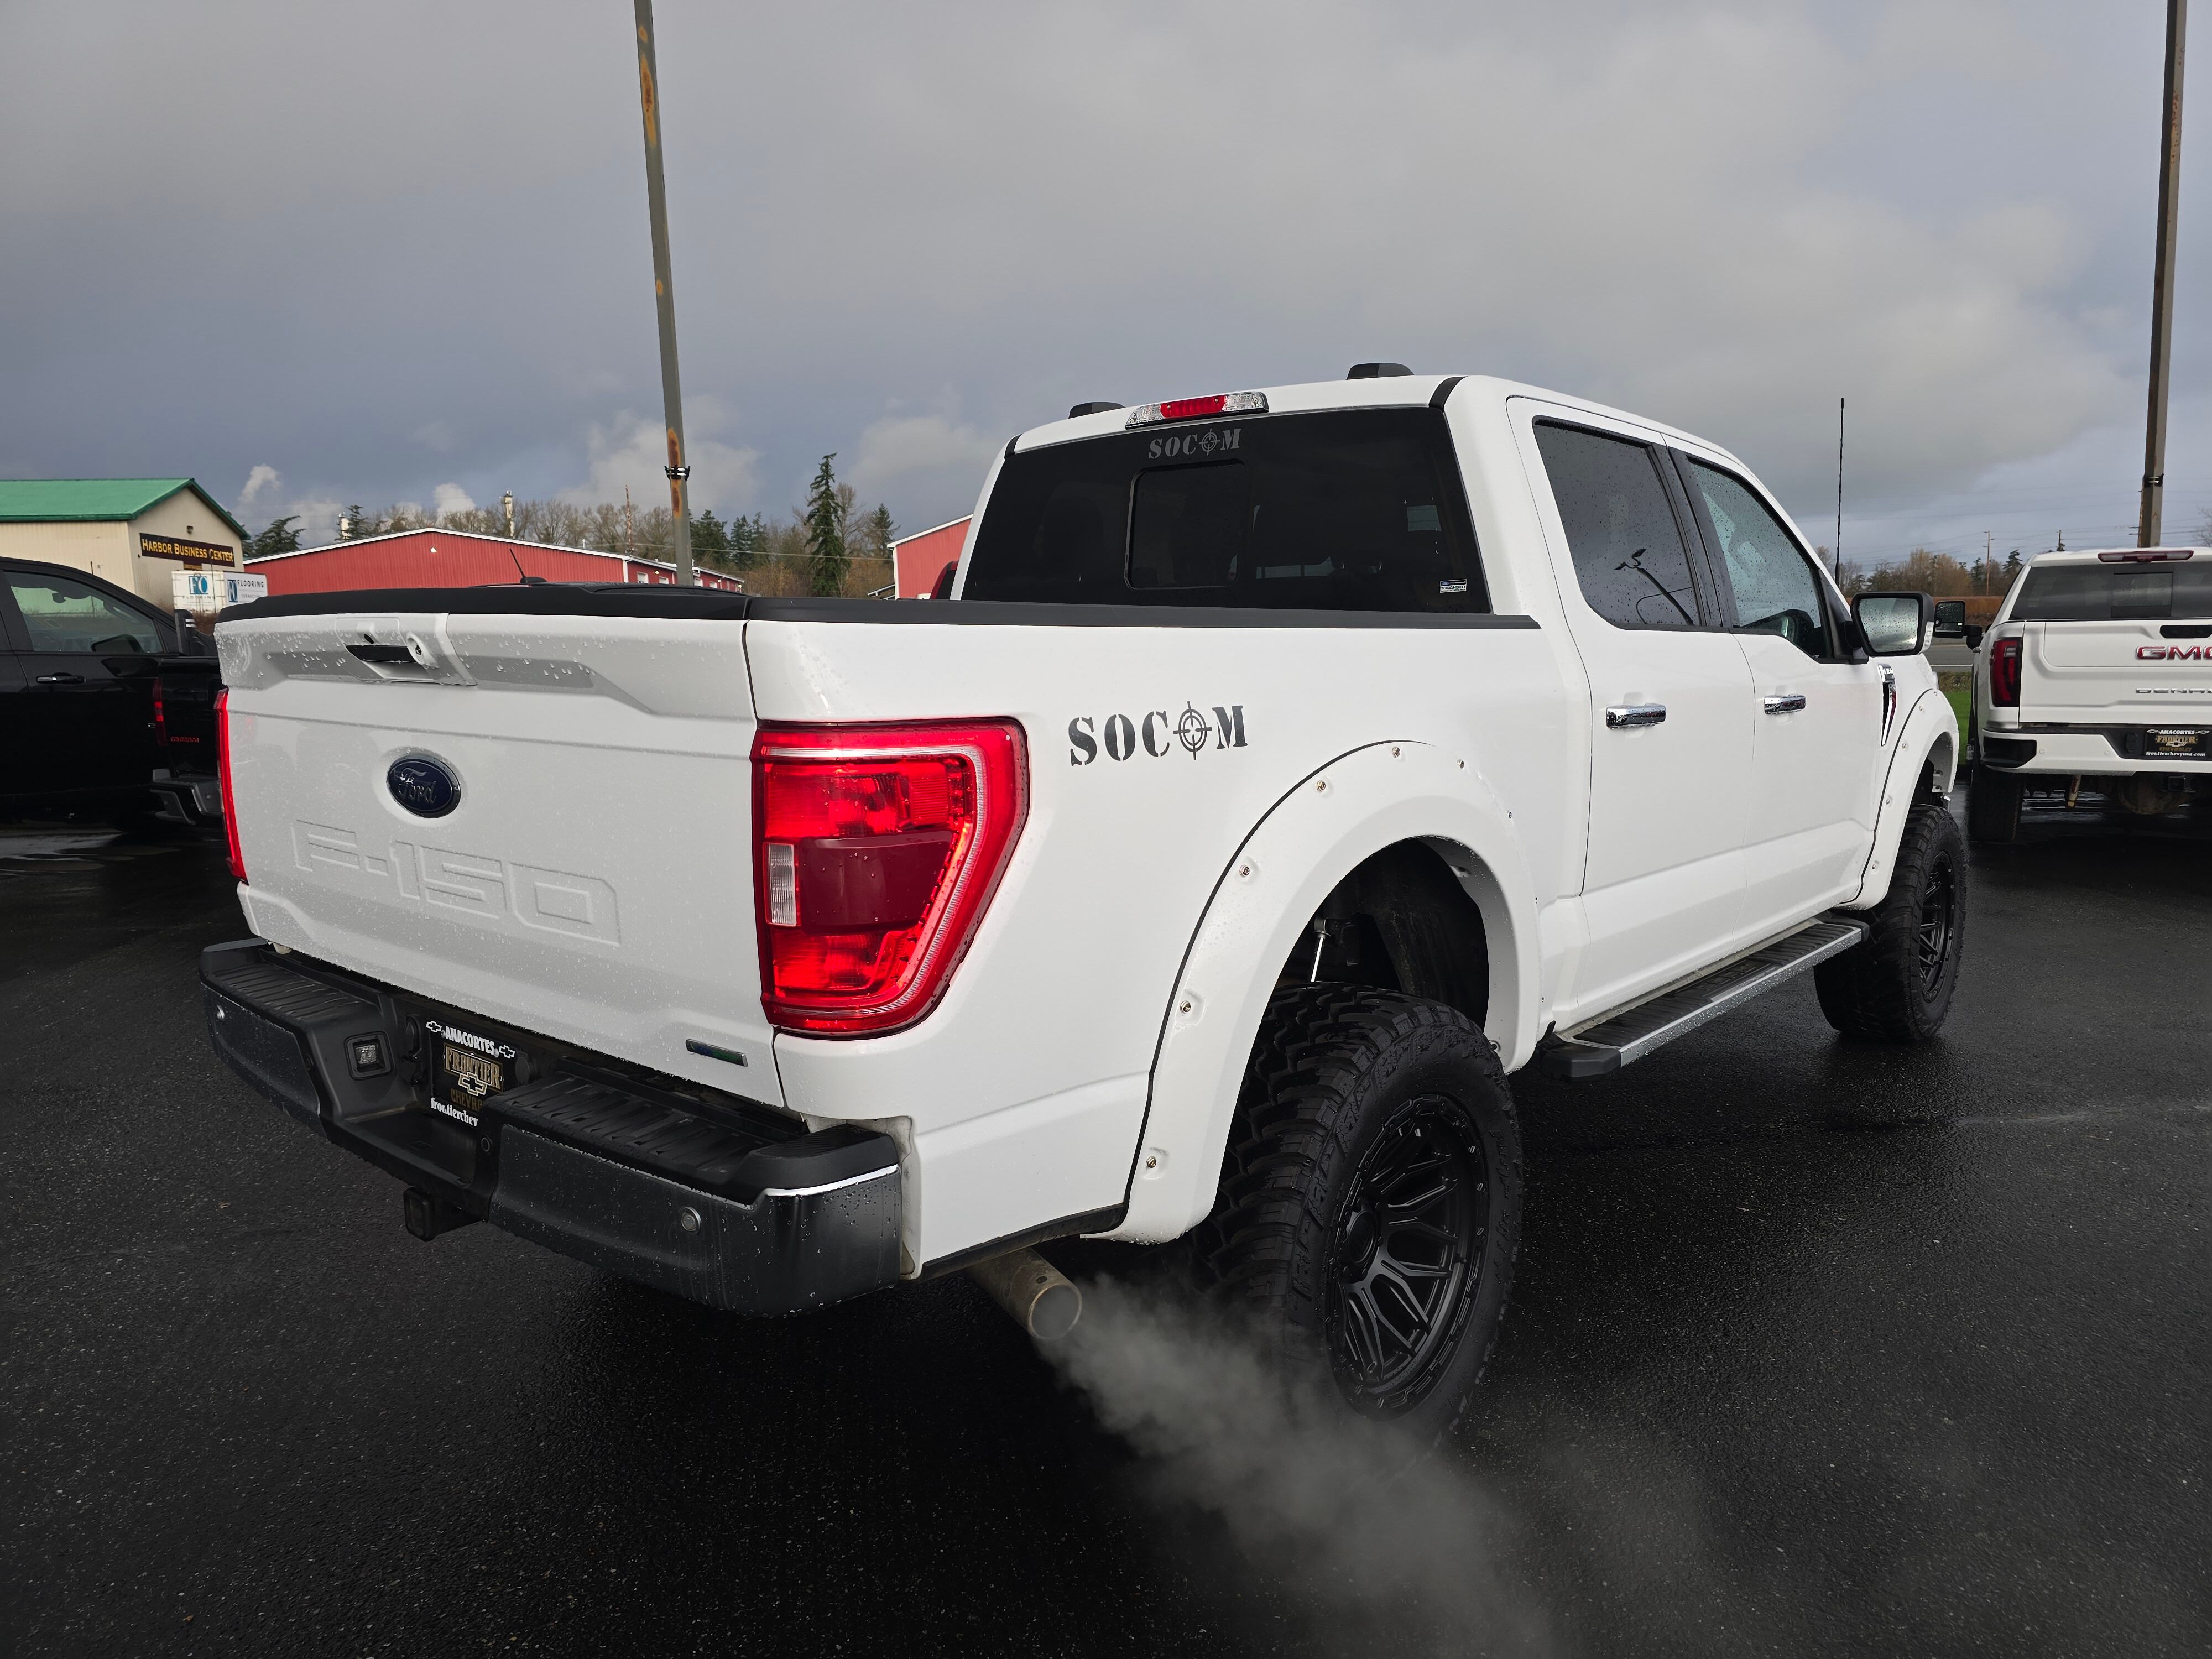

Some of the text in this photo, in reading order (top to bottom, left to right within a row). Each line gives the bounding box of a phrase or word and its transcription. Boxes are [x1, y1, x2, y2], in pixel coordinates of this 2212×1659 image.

[1148, 428, 1241, 460] SOCOM
[142, 538, 234, 563] HARBOR BUSINESS CENTER
[237, 580, 264, 588] FLOORING
[1068, 701, 1248, 766] SOCOM
[397, 767, 438, 804] Ford
[290, 819, 621, 947] F-150
[445, 1026, 495, 1055] ANACORTES
[445, 1046, 502, 1090] FRONTIER
